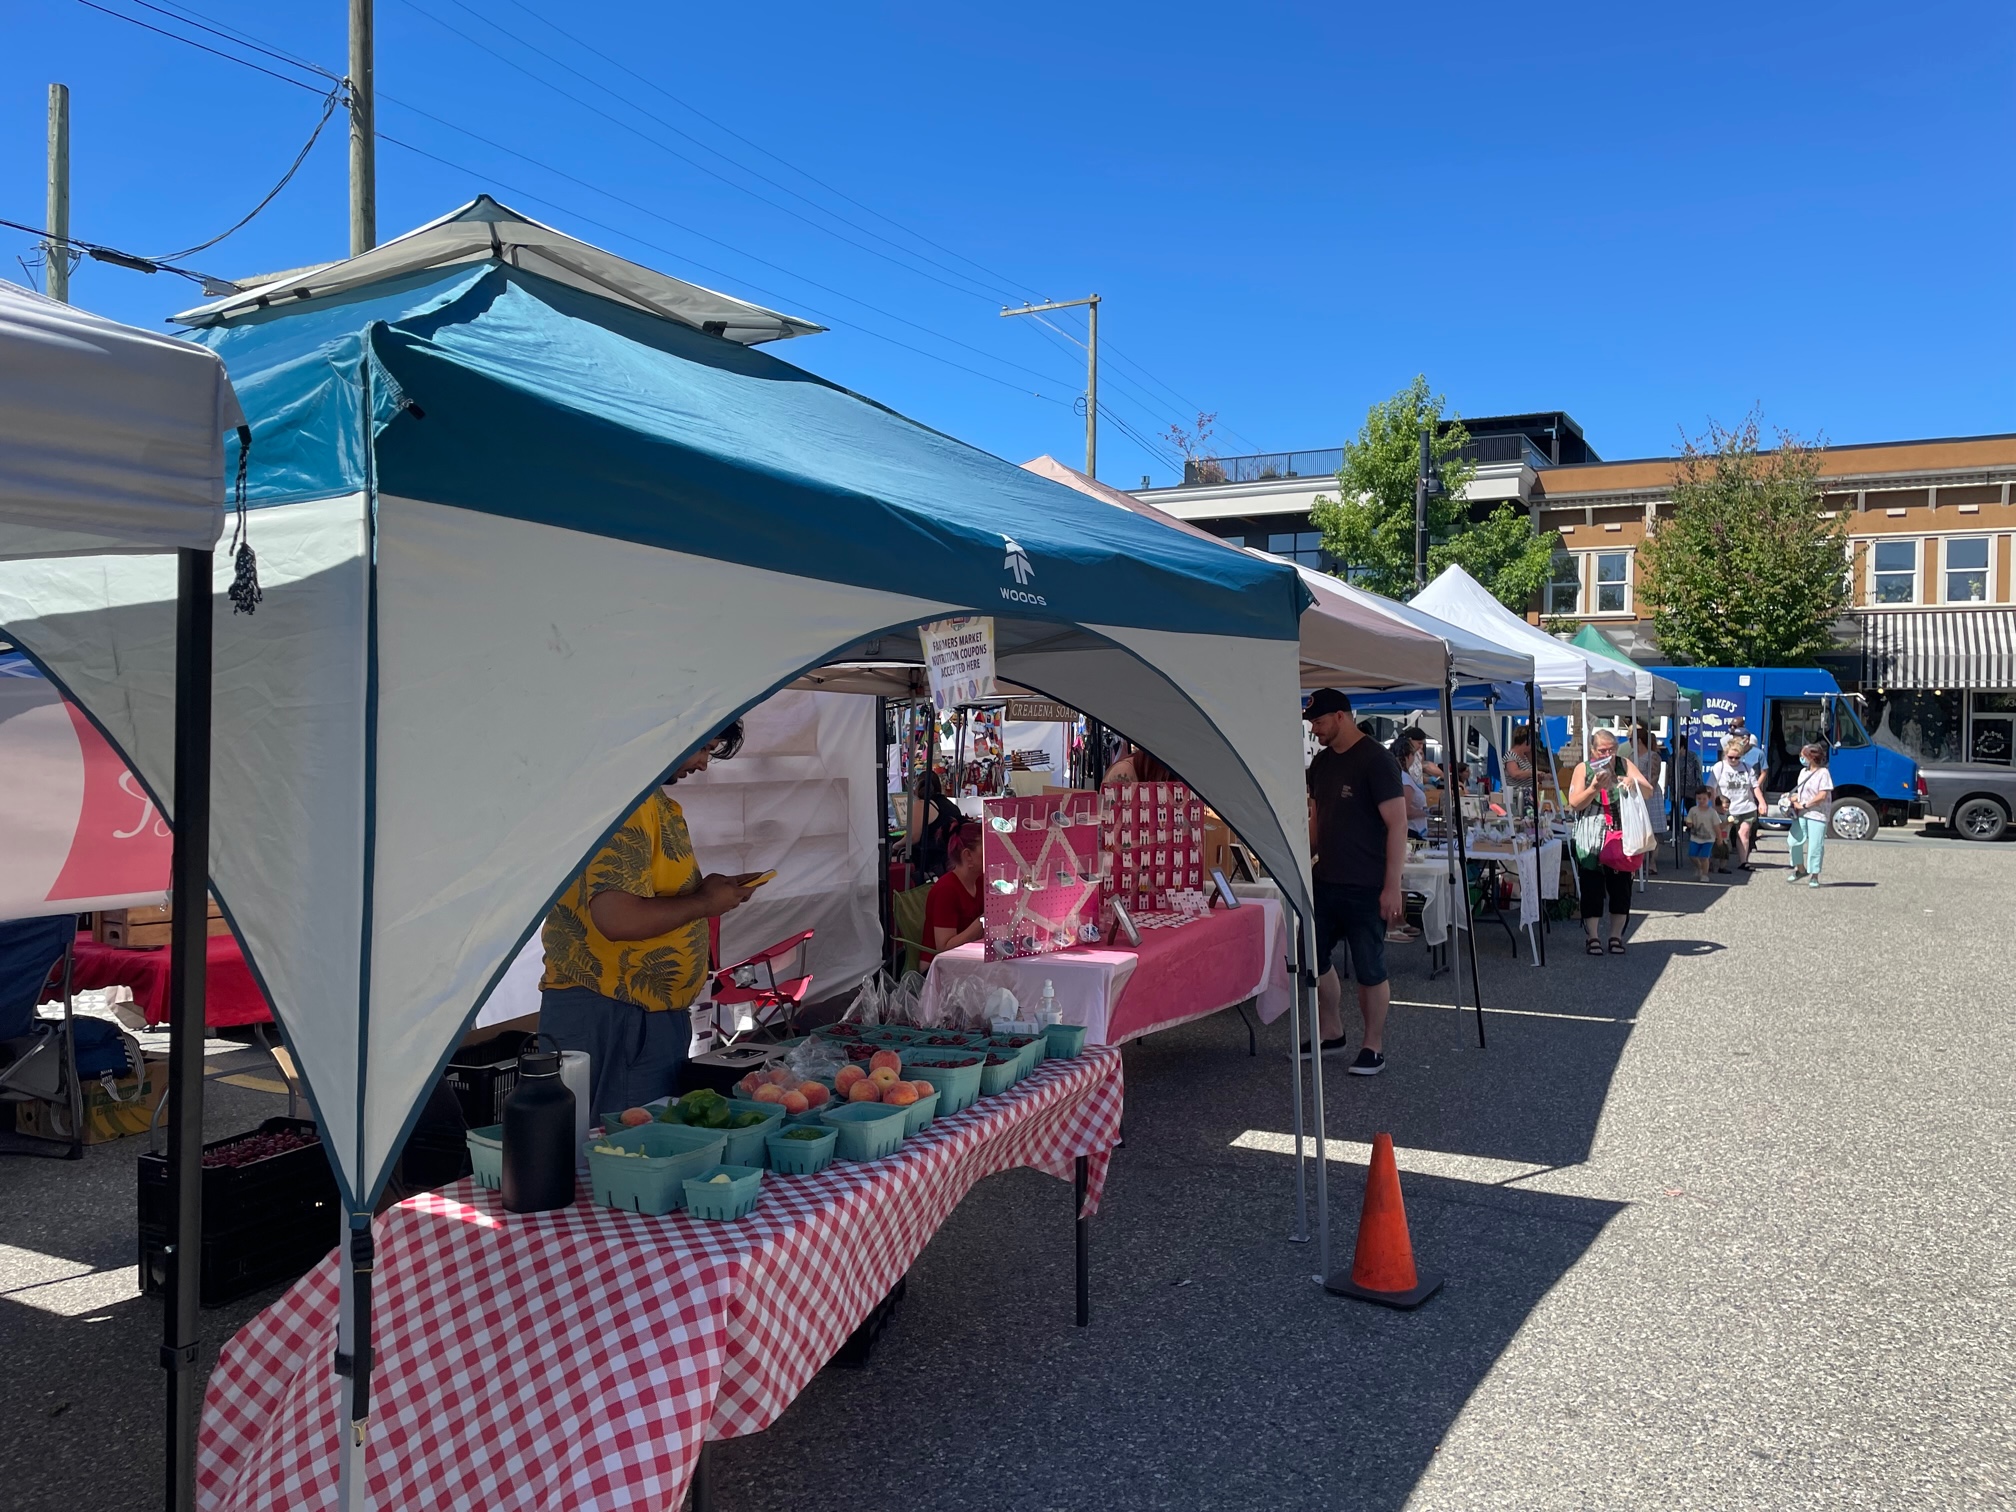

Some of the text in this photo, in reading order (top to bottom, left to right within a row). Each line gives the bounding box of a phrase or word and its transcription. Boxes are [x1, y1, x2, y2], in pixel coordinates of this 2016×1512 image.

[1000, 587, 1047, 606] WOODS
[933, 632, 982, 652] FARMERS MARKET
[932, 644, 987, 666] NUTRITION COUPONS
[941, 659, 981, 678] ACCEPTED HERE
[1012, 704, 1078, 718] CREALENA SOAPS
[1706, 698, 1738, 713] BAKER'S
